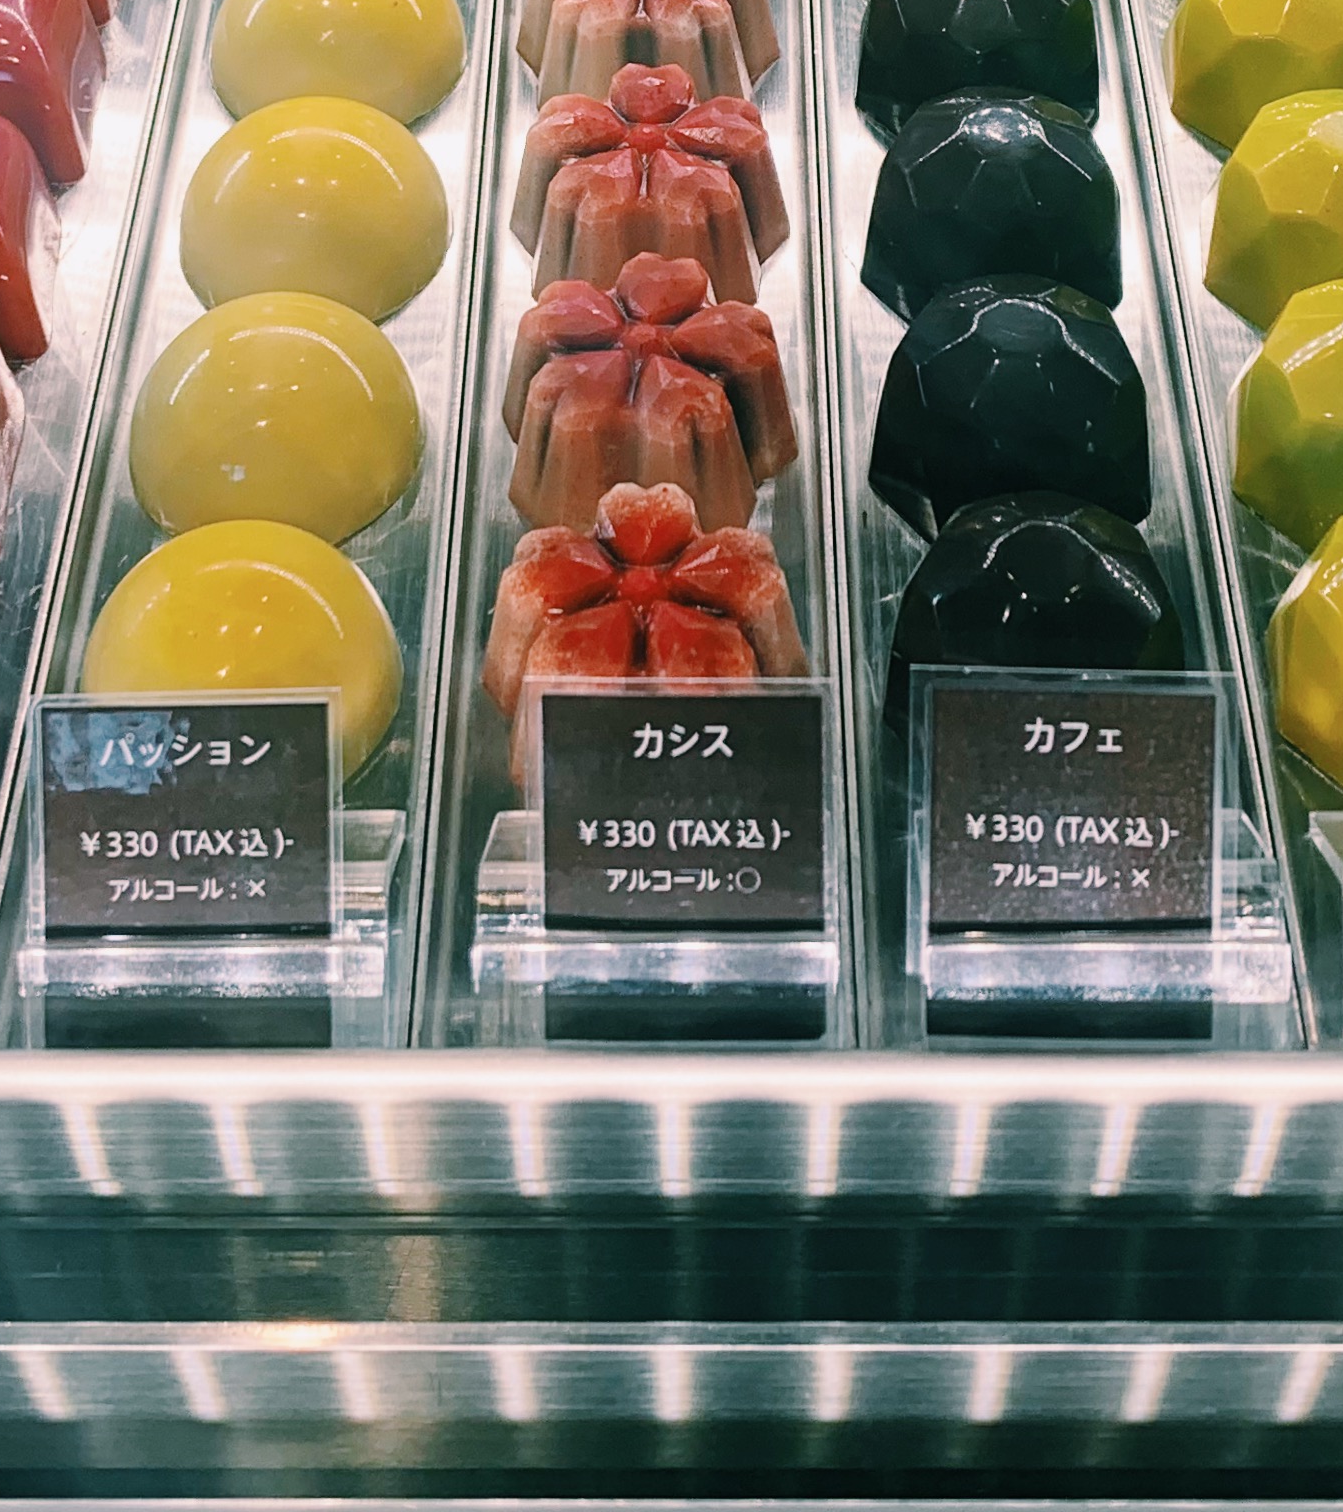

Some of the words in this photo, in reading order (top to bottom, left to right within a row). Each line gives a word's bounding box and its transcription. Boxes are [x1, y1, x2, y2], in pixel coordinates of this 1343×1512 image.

[99, 732, 271, 766] パッション
[633, 723, 733, 760] カシス
[1023, 718, 1123, 754] カフェ
